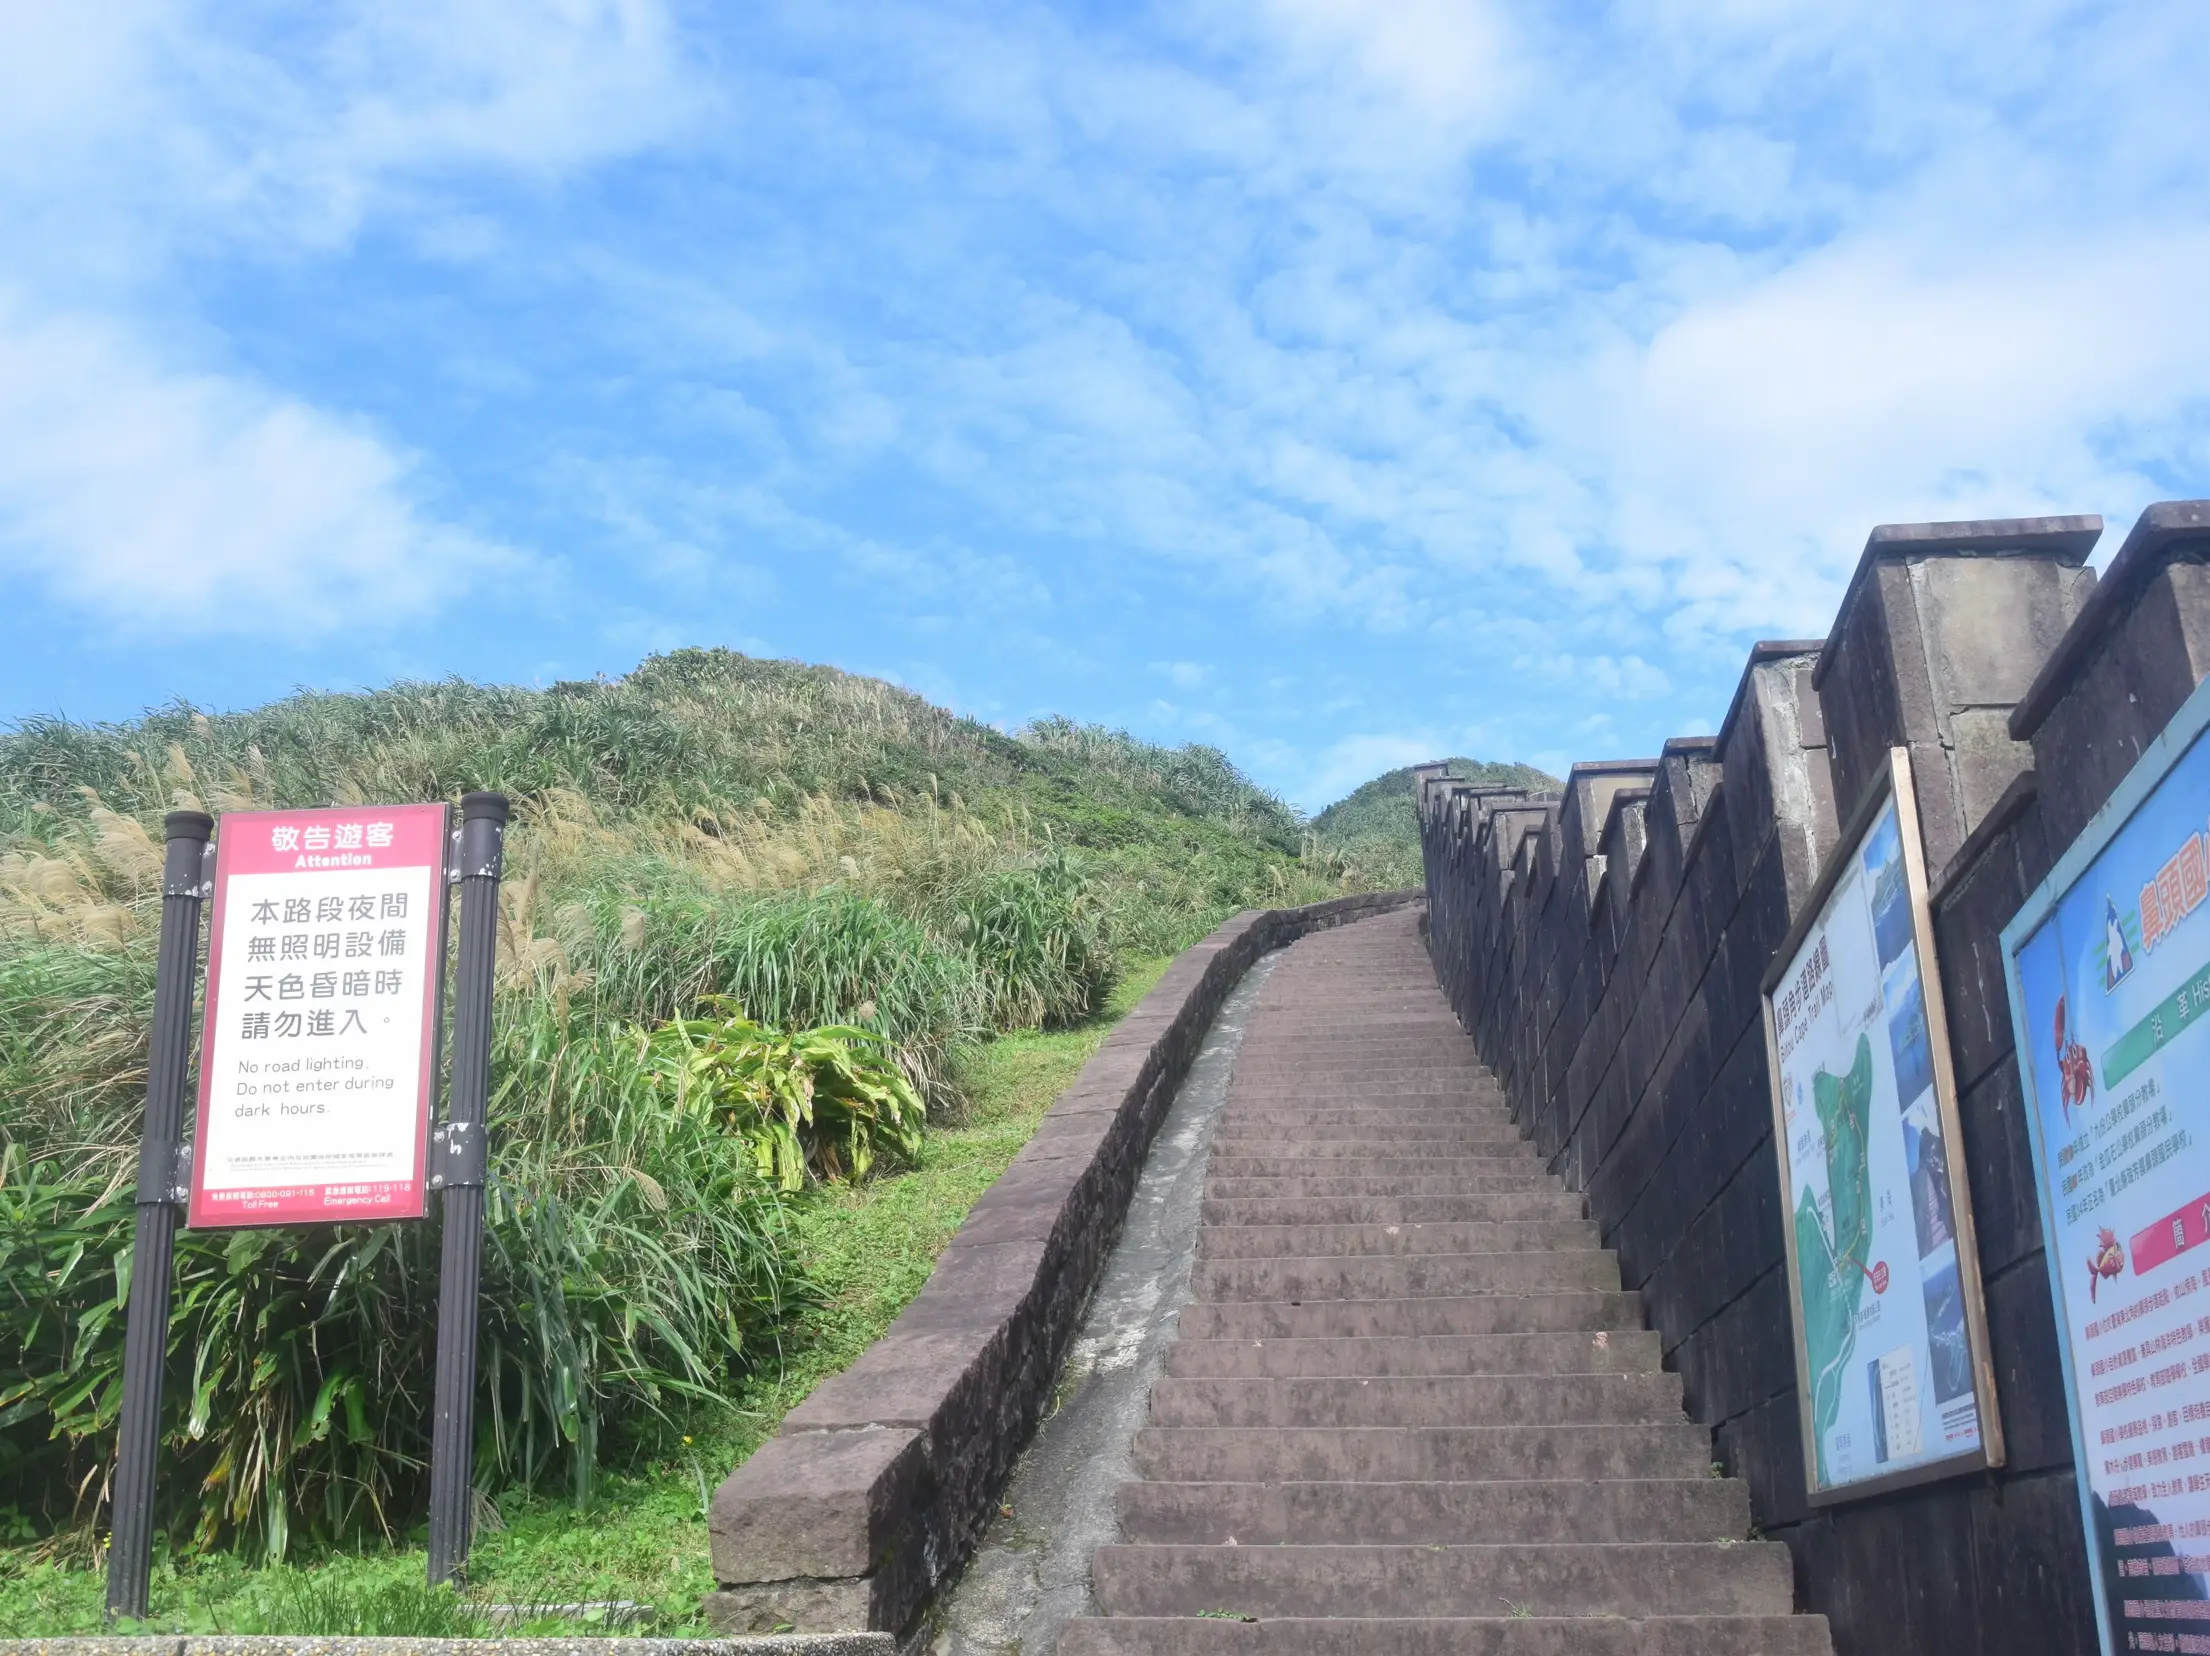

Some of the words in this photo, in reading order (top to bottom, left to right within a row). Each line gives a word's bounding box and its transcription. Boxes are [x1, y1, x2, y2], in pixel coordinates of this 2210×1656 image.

[271, 821, 395, 853] 敬告遊客
[294, 853, 373, 869] Attention
[2139, 814, 2210, 953] 鼻頭國
[250, 892, 409, 926] 本路段夜間
[247, 928, 407, 963] 無照明設備
[243, 968, 404, 1002] 天色昏暗時
[1794, 1017, 1808, 1044] Cape
[1807, 993, 1820, 1025] Trail
[1819, 980, 1833, 1006] Map
[237, 1060, 259, 1074] No
[264, 1059, 301, 1073] road
[305, 1057, 369, 1072] lighting.
[236, 1082, 258, 1096] Do
[262, 1080, 290, 1094] not
[295, 1079, 340, 1092] enter
[344, 1076, 395, 1090] during
[234, 1102, 271, 1118] dark
[280, 1102, 331, 1116] hours.
[242, 1200, 257, 1209] Toll
[258, 1200, 279, 1208] Free
[324, 1196, 373, 1207] Emergency
[374, 1194, 391, 1203] Call
